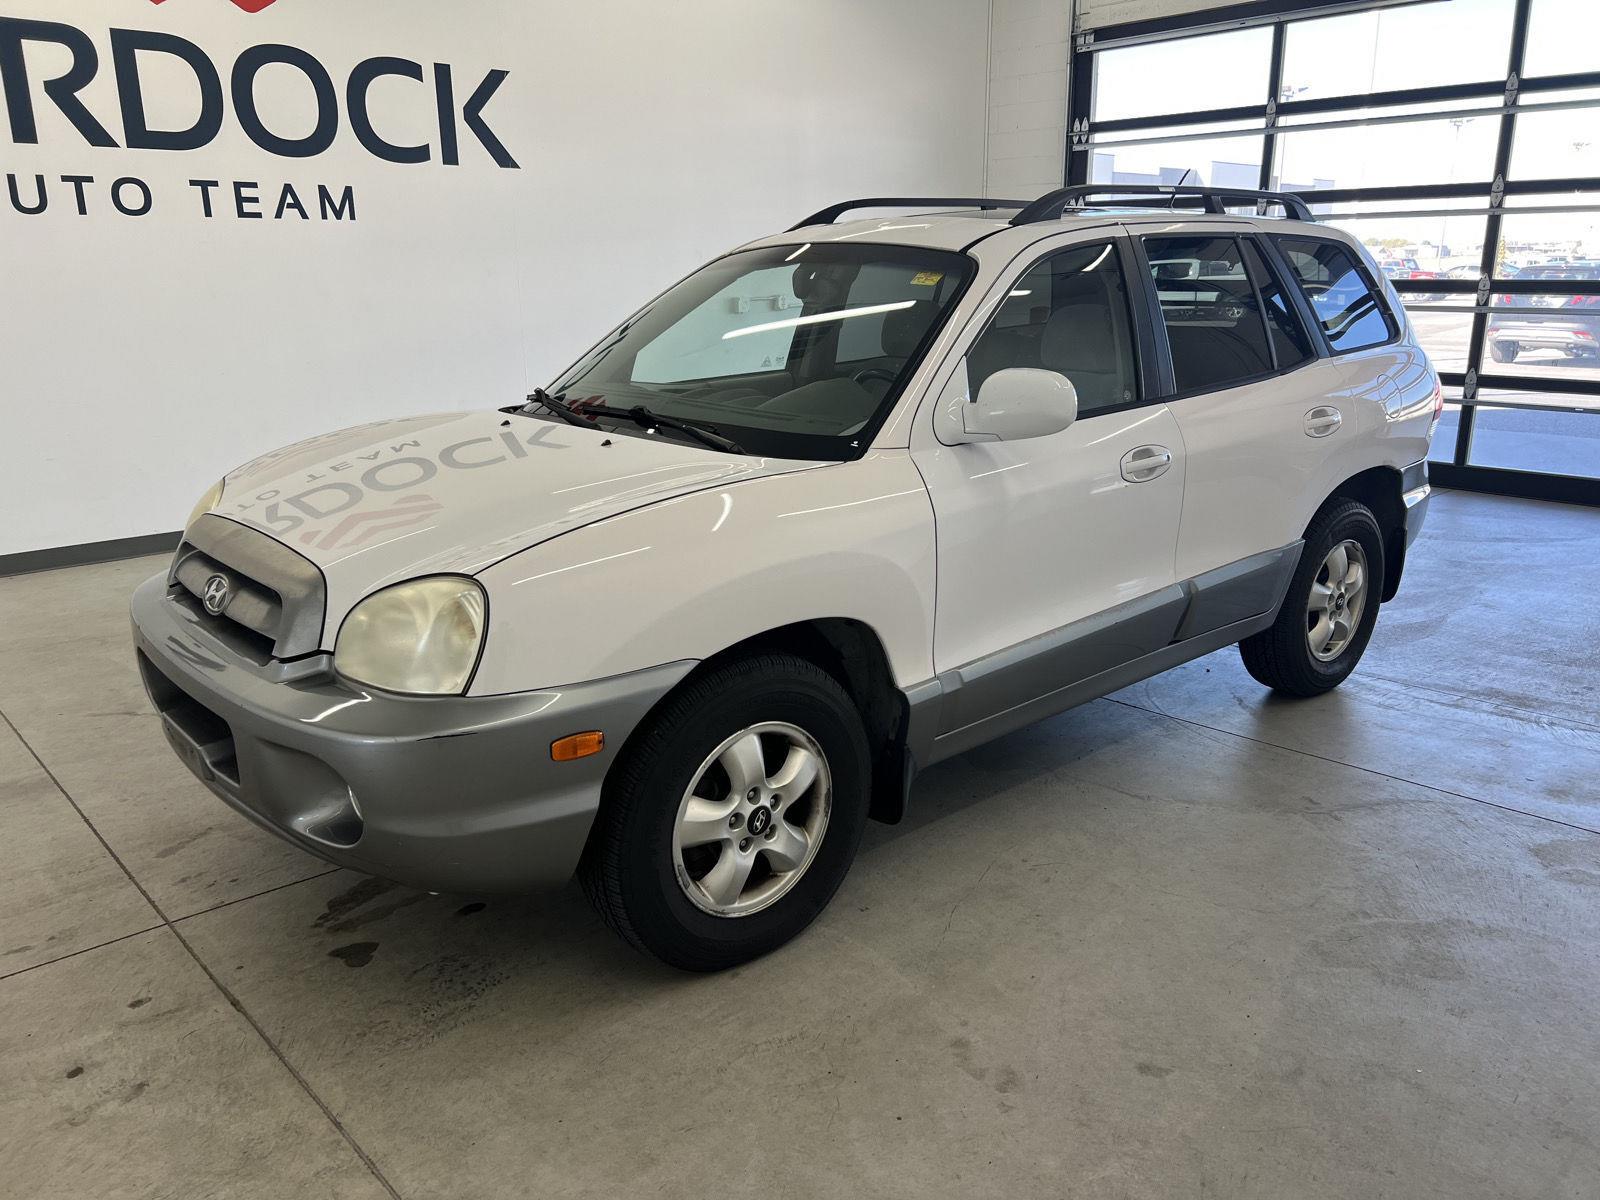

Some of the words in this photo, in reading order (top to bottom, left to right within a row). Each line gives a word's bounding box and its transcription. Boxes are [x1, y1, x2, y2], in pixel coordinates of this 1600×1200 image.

[0, 16, 521, 170] RDOCK
[6, 173, 153, 217] UTO
[188, 179, 357, 221] TEAM
